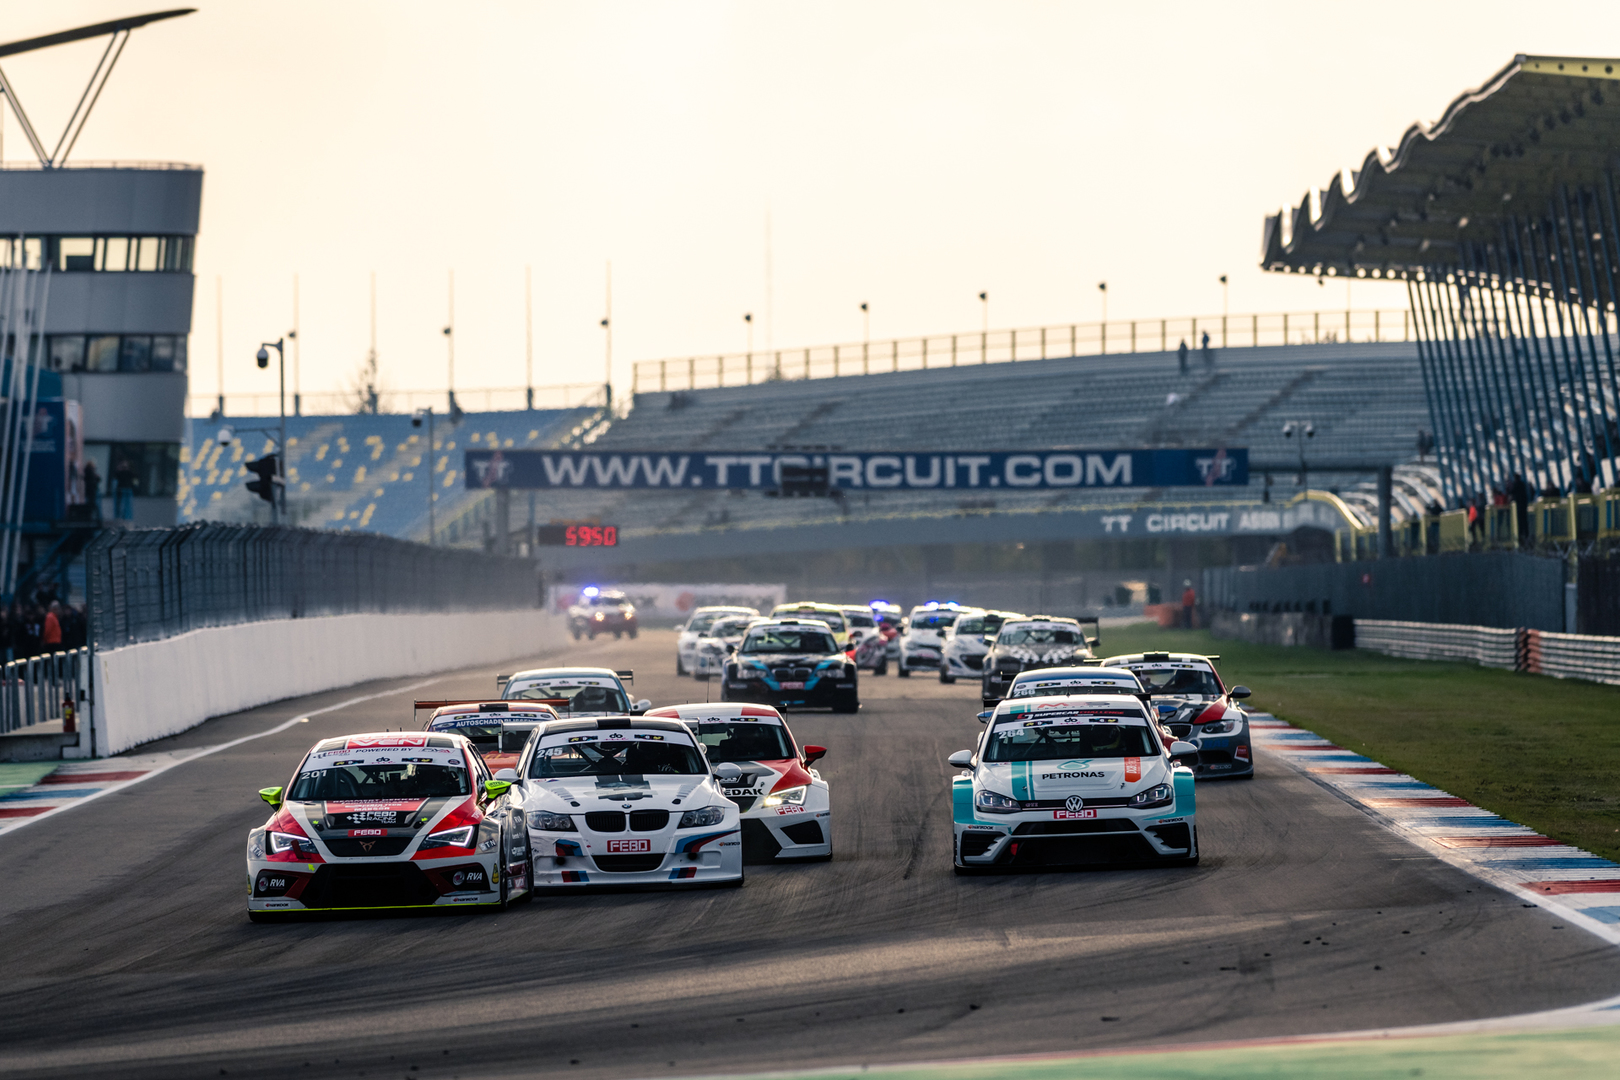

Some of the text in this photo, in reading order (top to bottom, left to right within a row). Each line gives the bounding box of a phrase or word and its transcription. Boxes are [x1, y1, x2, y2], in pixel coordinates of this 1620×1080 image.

[1102, 515, 1132, 533] TT
[1146, 513, 1231, 532] CIRCUIT
[565, 526, 617, 547] 5950
[1034, 710, 1079, 718] SUPERCAR
[999, 729, 1025, 740] 264
[537, 747, 563, 759] 245
[301, 770, 328, 780] 201
[1041, 771, 1106, 780] PETRONAS
[725, 788, 764, 796] EDAK
[774, 805, 807, 816] FEBO
[1056, 809, 1094, 819] FEBO
[480, 840, 496, 851] STN
[610, 840, 648, 852] FEBO
[466, 872, 483, 881] RVA
[269, 878, 285, 887] RVA
